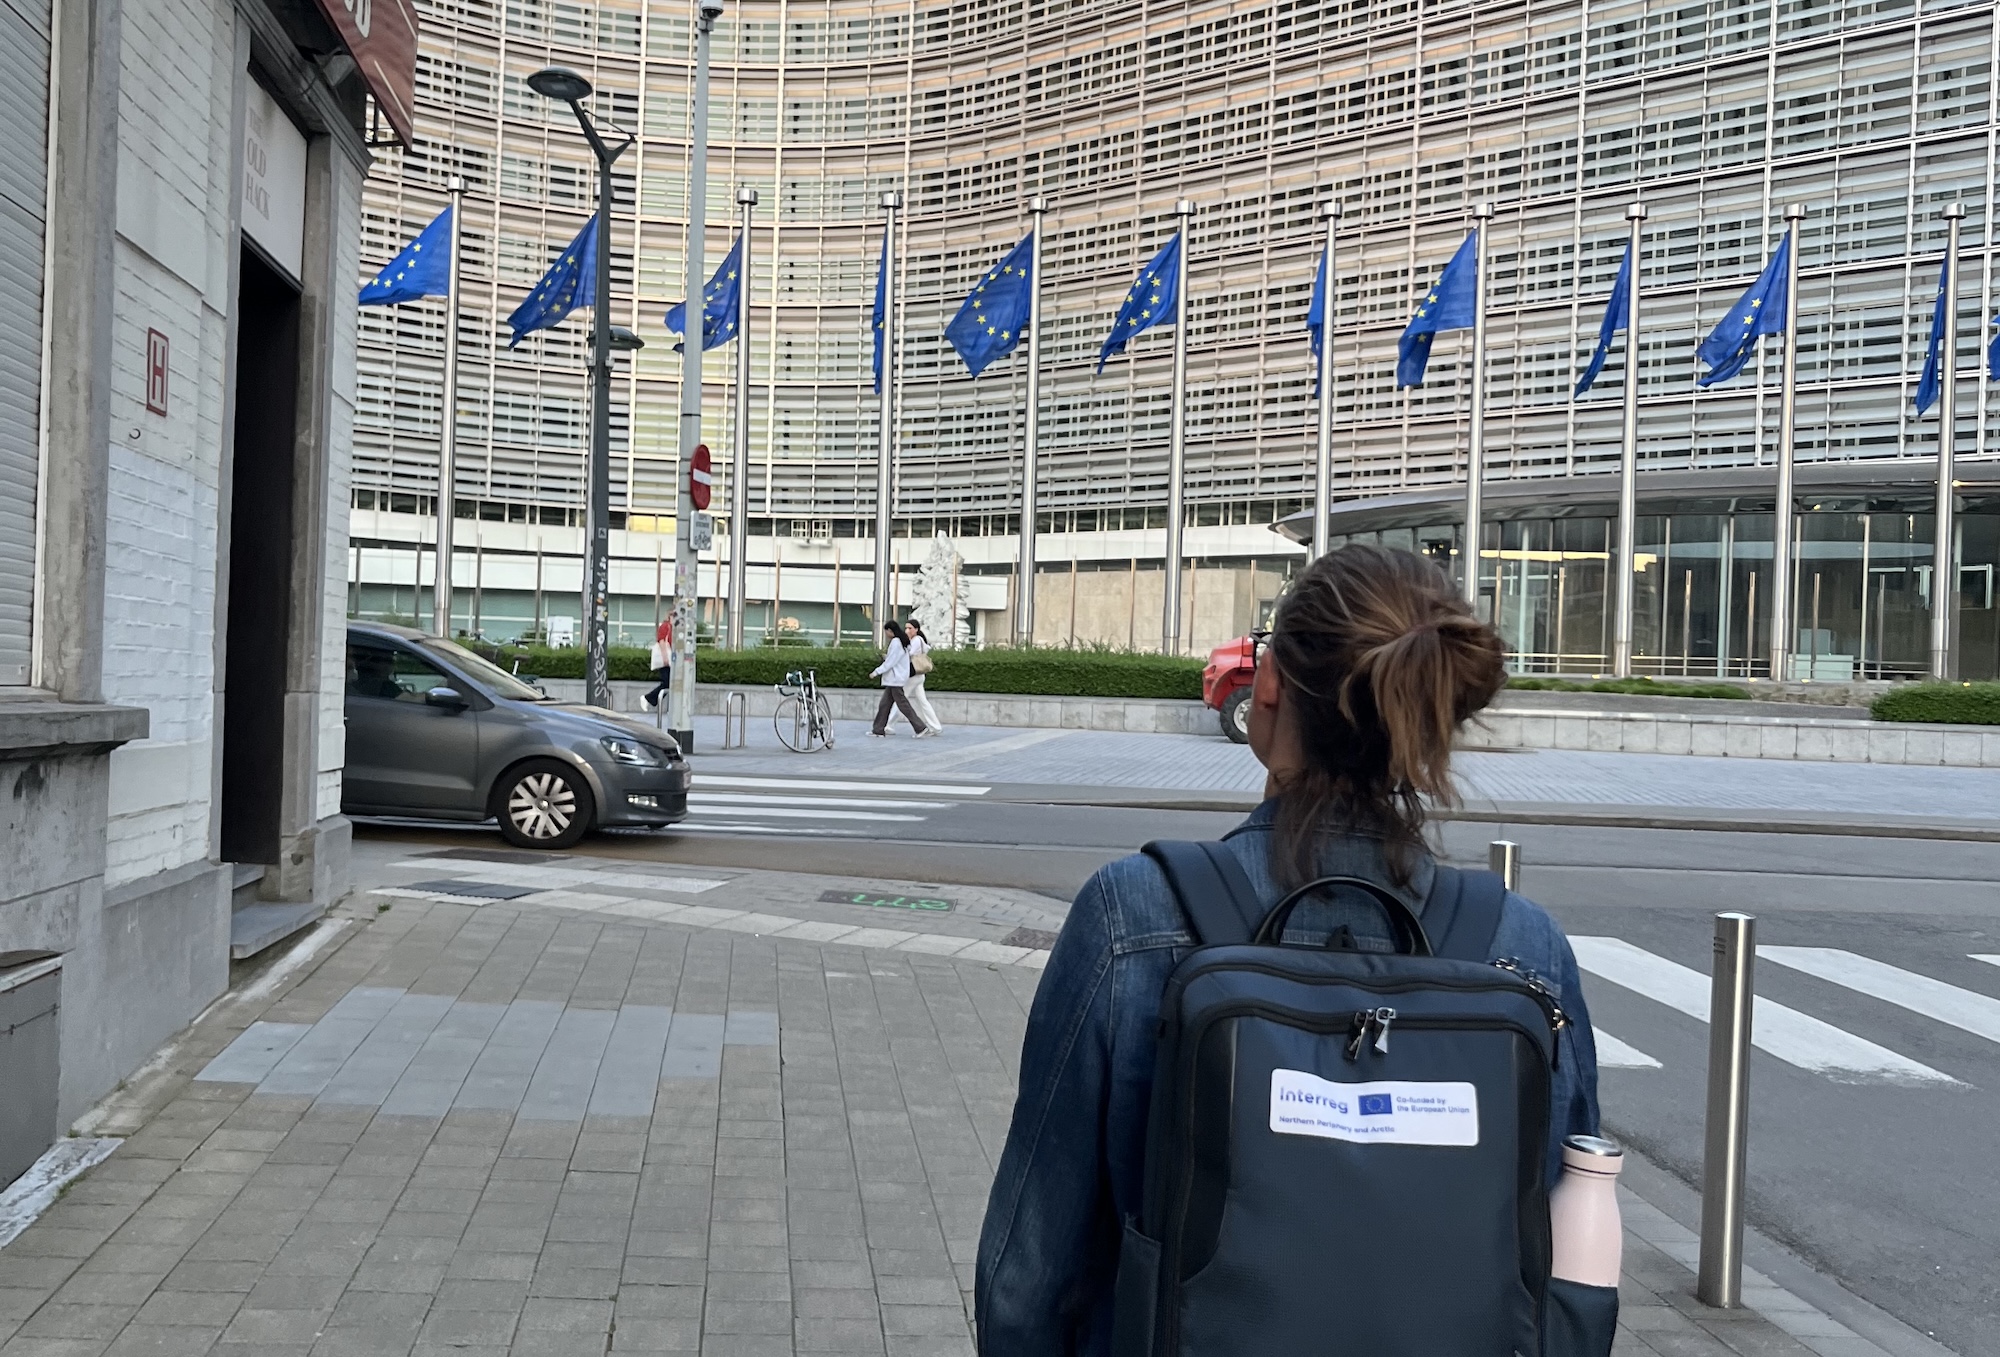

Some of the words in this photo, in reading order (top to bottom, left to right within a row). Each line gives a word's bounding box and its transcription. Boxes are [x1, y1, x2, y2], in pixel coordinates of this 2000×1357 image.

[247, 138, 267, 178] OLD
[152, 340, 166, 404] H
[1280, 1087, 1349, 1114] Interreg
[1396, 1096, 1435, 1104] Co-funded
[1436, 1097, 1446, 1106] by
[1411, 1105, 1446, 1113] European
[1279, 1116, 1315, 1125] Northern
[1317, 1119, 1352, 1133] Periphery
